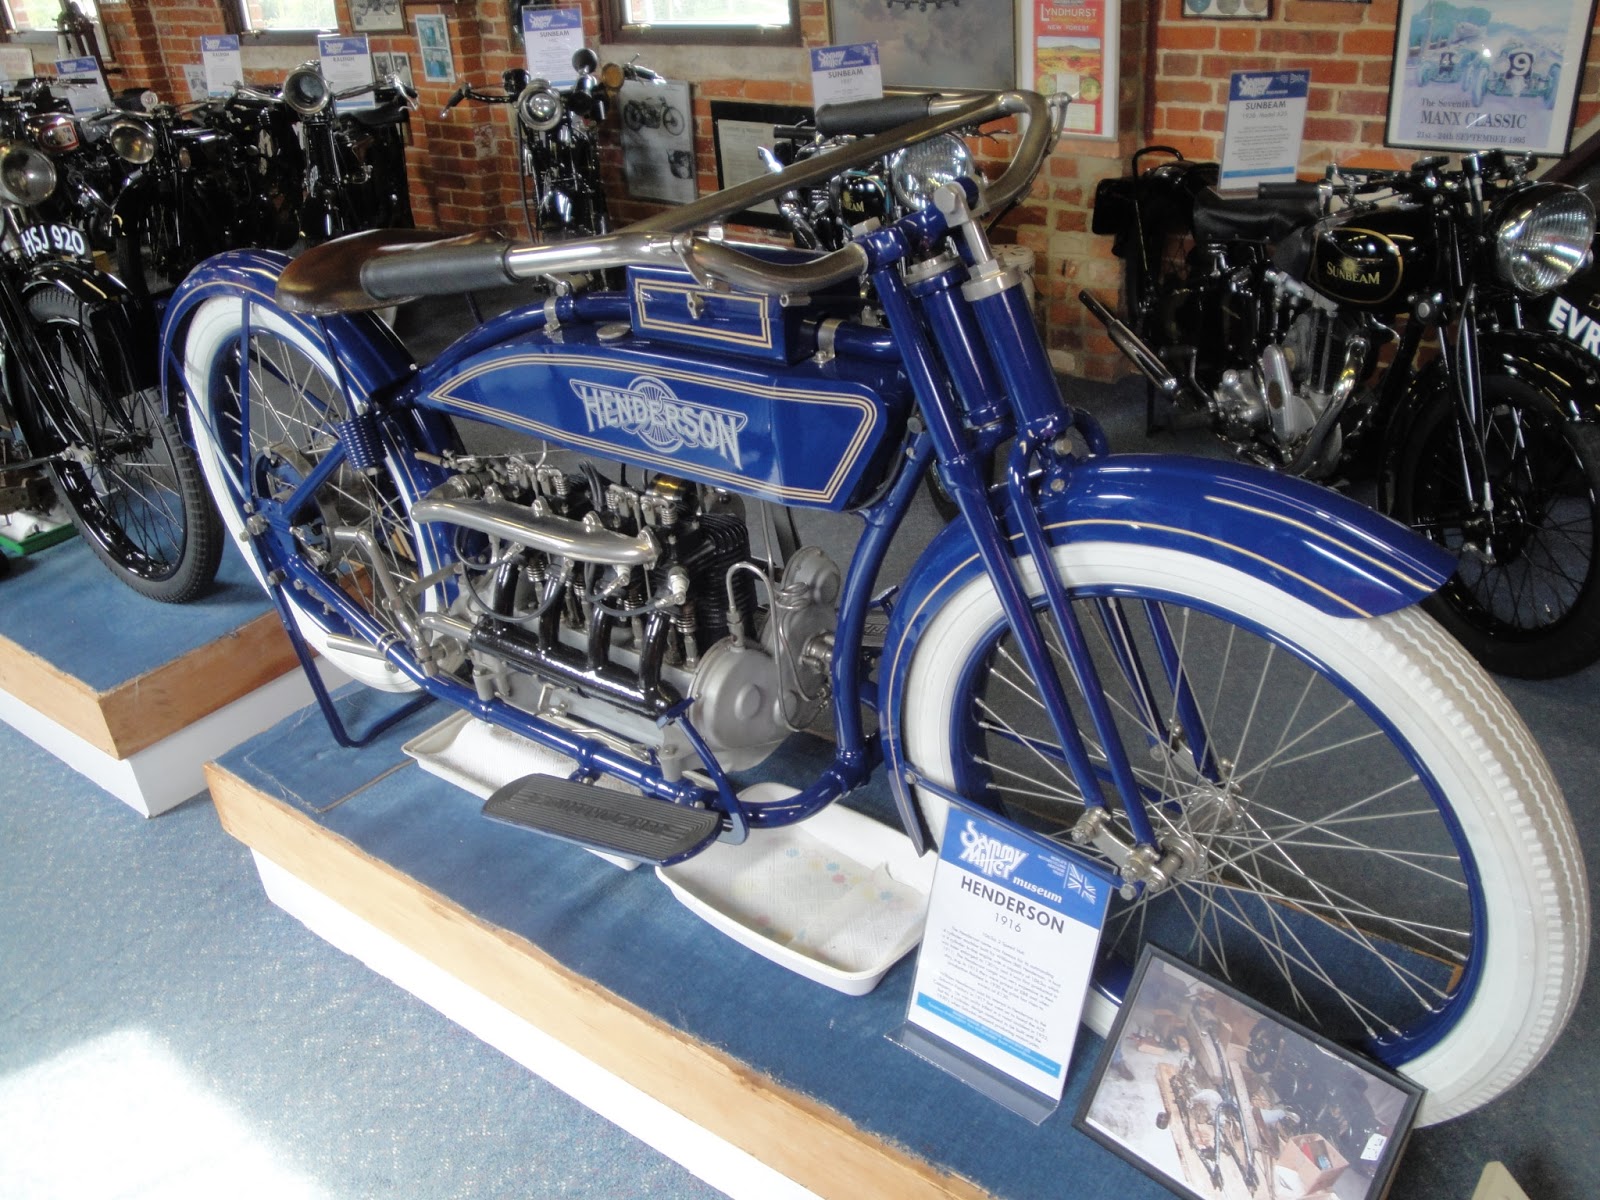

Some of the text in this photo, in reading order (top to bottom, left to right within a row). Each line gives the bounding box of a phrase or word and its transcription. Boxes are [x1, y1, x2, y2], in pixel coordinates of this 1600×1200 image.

[1040, 3, 1097, 22] LYNDHURST
[539, 30, 570, 38] SUNBEAM
[828, 69, 863, 78] SUNBEAM
[1512, 53, 1532, 76] 9
[1245, 101, 1286, 110] SUNBEAM
[1421, 97, 1471, 109] The Seventh
[1420, 110, 1528, 129] MANX CLASSIC
[1455, 132, 1506, 144] SEPTEMBER
[20, 224, 85, 258] HSJ 920
[1326, 260, 1381, 285] SUNBEAM
[578, 384, 744, 471] HENDERSON
[959, 819, 1030, 875] Sammy
[1011, 875, 1064, 905] museum
[960, 875, 1065, 934] HENDERSON
[993, 912, 1022, 933] 1916
